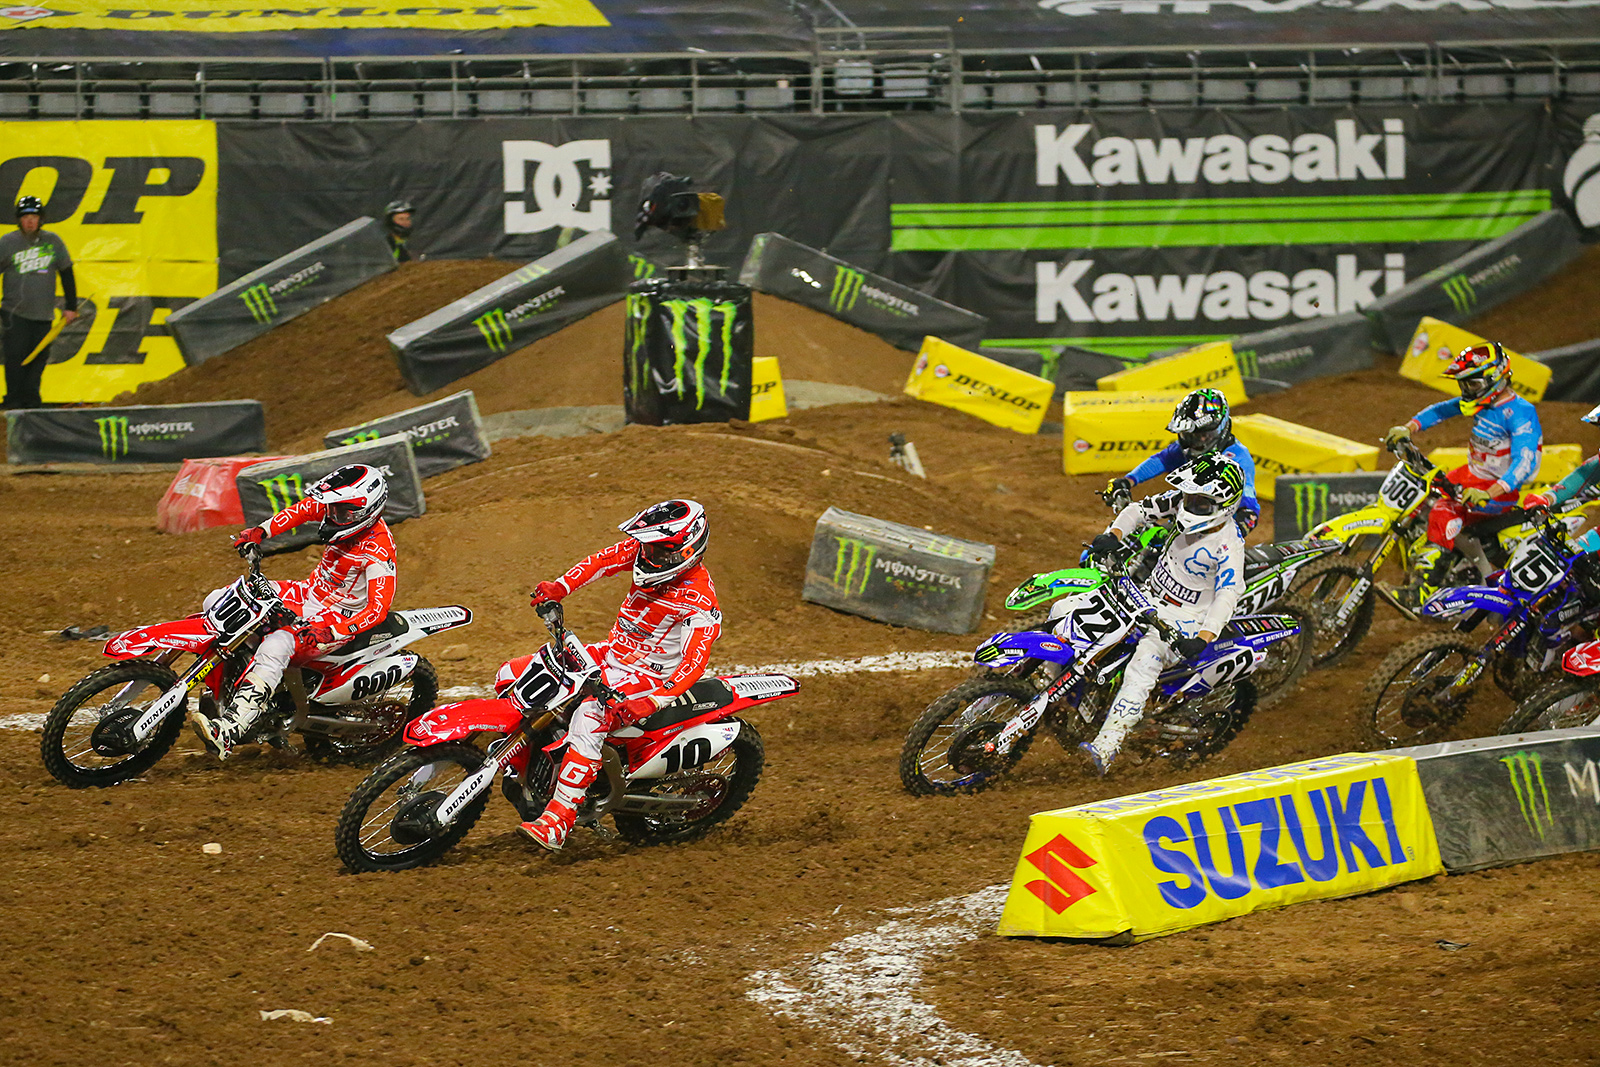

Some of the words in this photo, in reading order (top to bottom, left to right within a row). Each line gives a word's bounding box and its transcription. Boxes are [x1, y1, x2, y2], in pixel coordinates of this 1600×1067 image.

[1034, 117, 1406, 187] Kawasaki
[502, 138, 612, 235] DC
[14, 248, 41, 265] FLAG
[20, 255, 53, 274] CREW
[504, 285, 566, 320] MONSTER
[1034, 252, 1406, 324] Kawasaki
[952, 373, 1042, 413] DUNLOP
[129, 422, 195, 435] MONSTER
[405, 415, 461, 440] NSTER
[1098, 439, 1172, 452] DUNL
[1381, 475, 1419, 509] 509
[875, 557, 962, 590] MONSTER
[1158, 566, 1200, 605] YAMAHA
[1511, 548, 1561, 590] 15
[429, 623, 452, 631] DUNLOP
[1072, 594, 1122, 642] 22
[1265, 629, 1293, 642] DUNLOP
[1003, 648, 1024, 657] YAMAHA
[1212, 649, 1251, 688] 22
[351, 664, 403, 701] 800
[515, 661, 560, 710] 10
[758, 691, 782, 700] DUNLOP
[1049, 673, 1082, 703] YAMAHA
[139, 693, 177, 732] DUNLOP
[660, 737, 712, 775] 10
[444, 773, 485, 816] DUNLOP
[1143, 777, 1407, 910] SUZUKI
